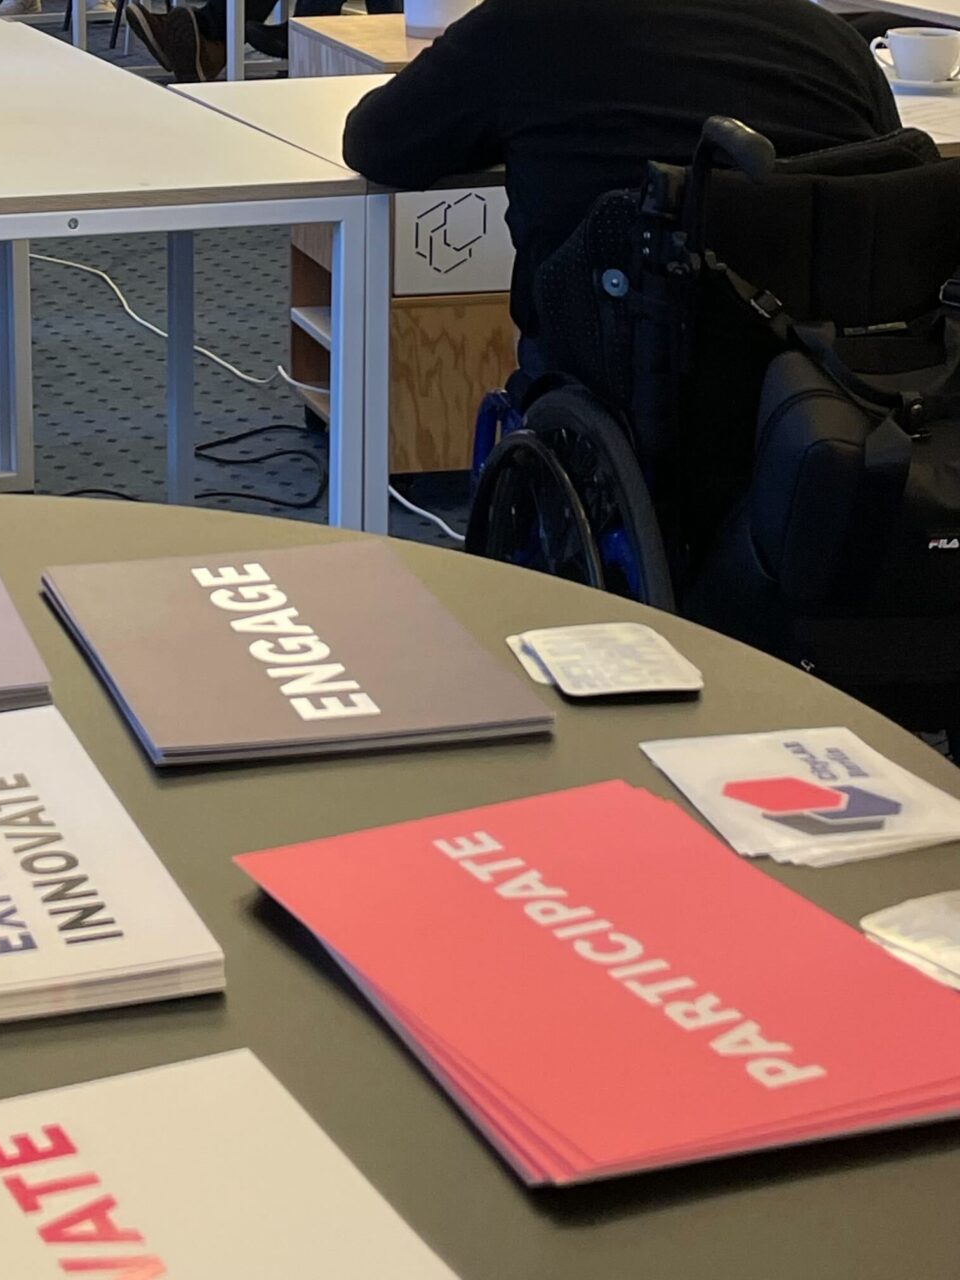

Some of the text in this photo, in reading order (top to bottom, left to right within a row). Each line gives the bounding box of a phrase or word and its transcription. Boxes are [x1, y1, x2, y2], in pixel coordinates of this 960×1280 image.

[928, 536, 960, 549] FILA
[191, 562, 381, 720] ENGAGE
[432, 830, 827, 1088] PARTICIPATE
